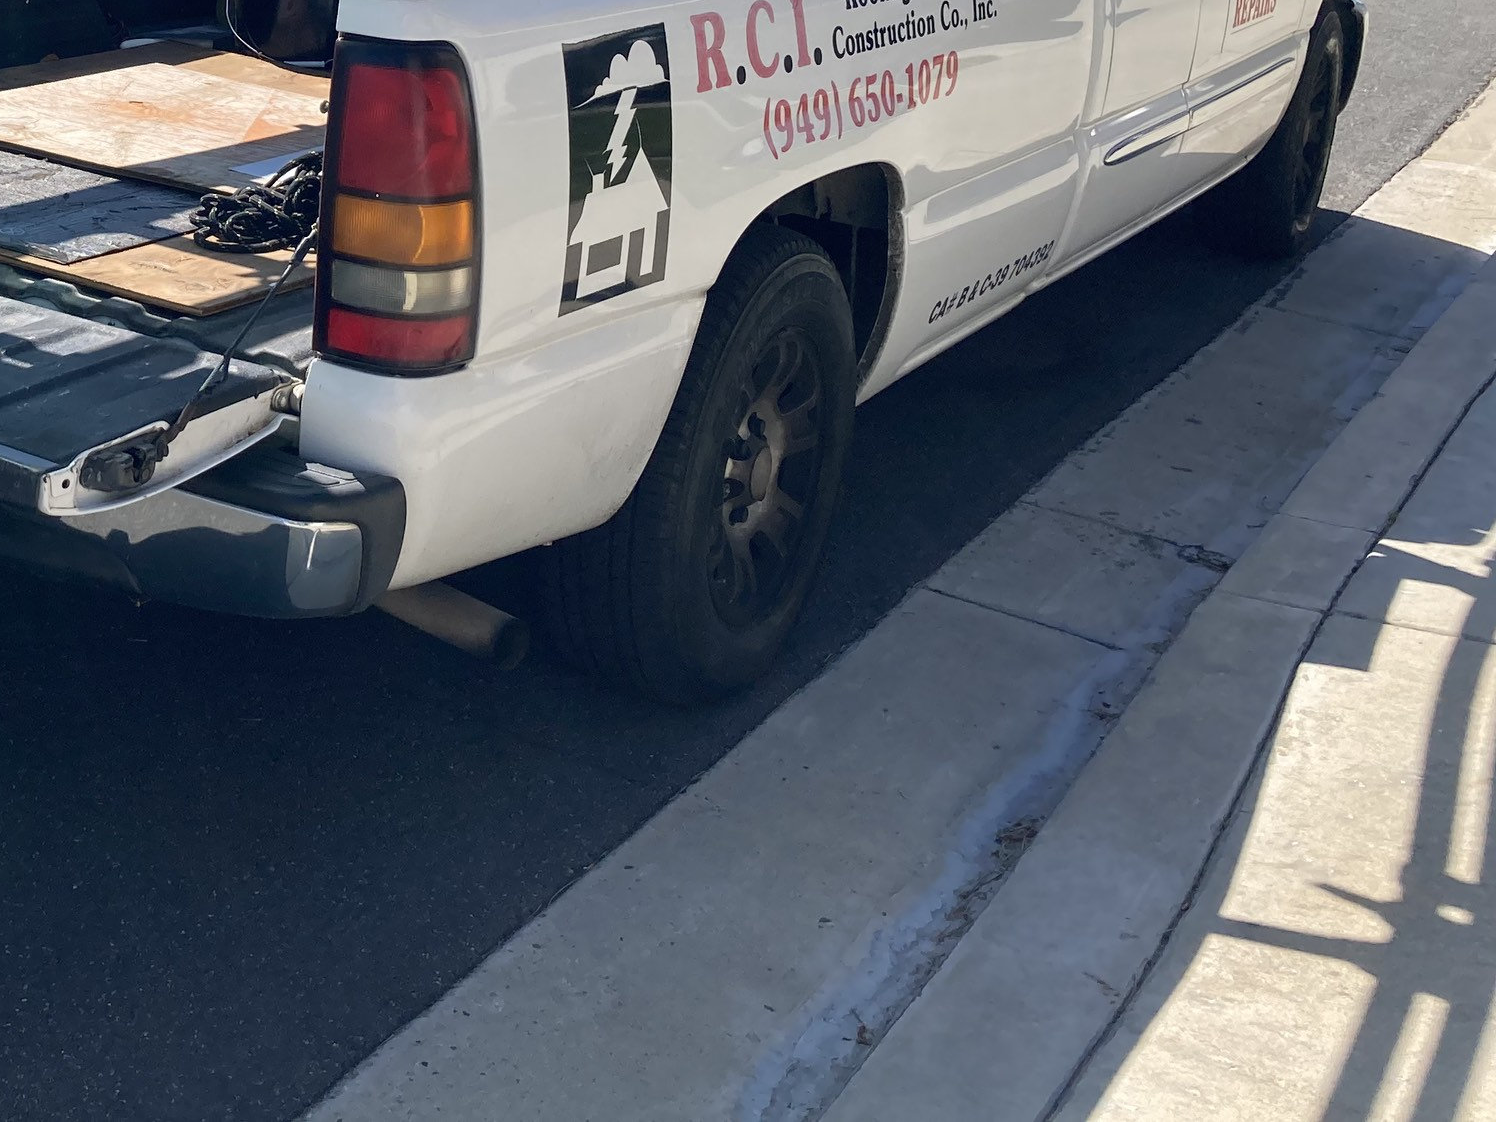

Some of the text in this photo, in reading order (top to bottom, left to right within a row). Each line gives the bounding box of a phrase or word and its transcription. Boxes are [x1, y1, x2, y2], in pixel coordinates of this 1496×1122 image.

[832, 9, 936, 59] Construction
[940, 0, 969, 32] Co.,
[763, 50, 959, 160] (949) 650-1079
[967, 279, 980, 303] &
